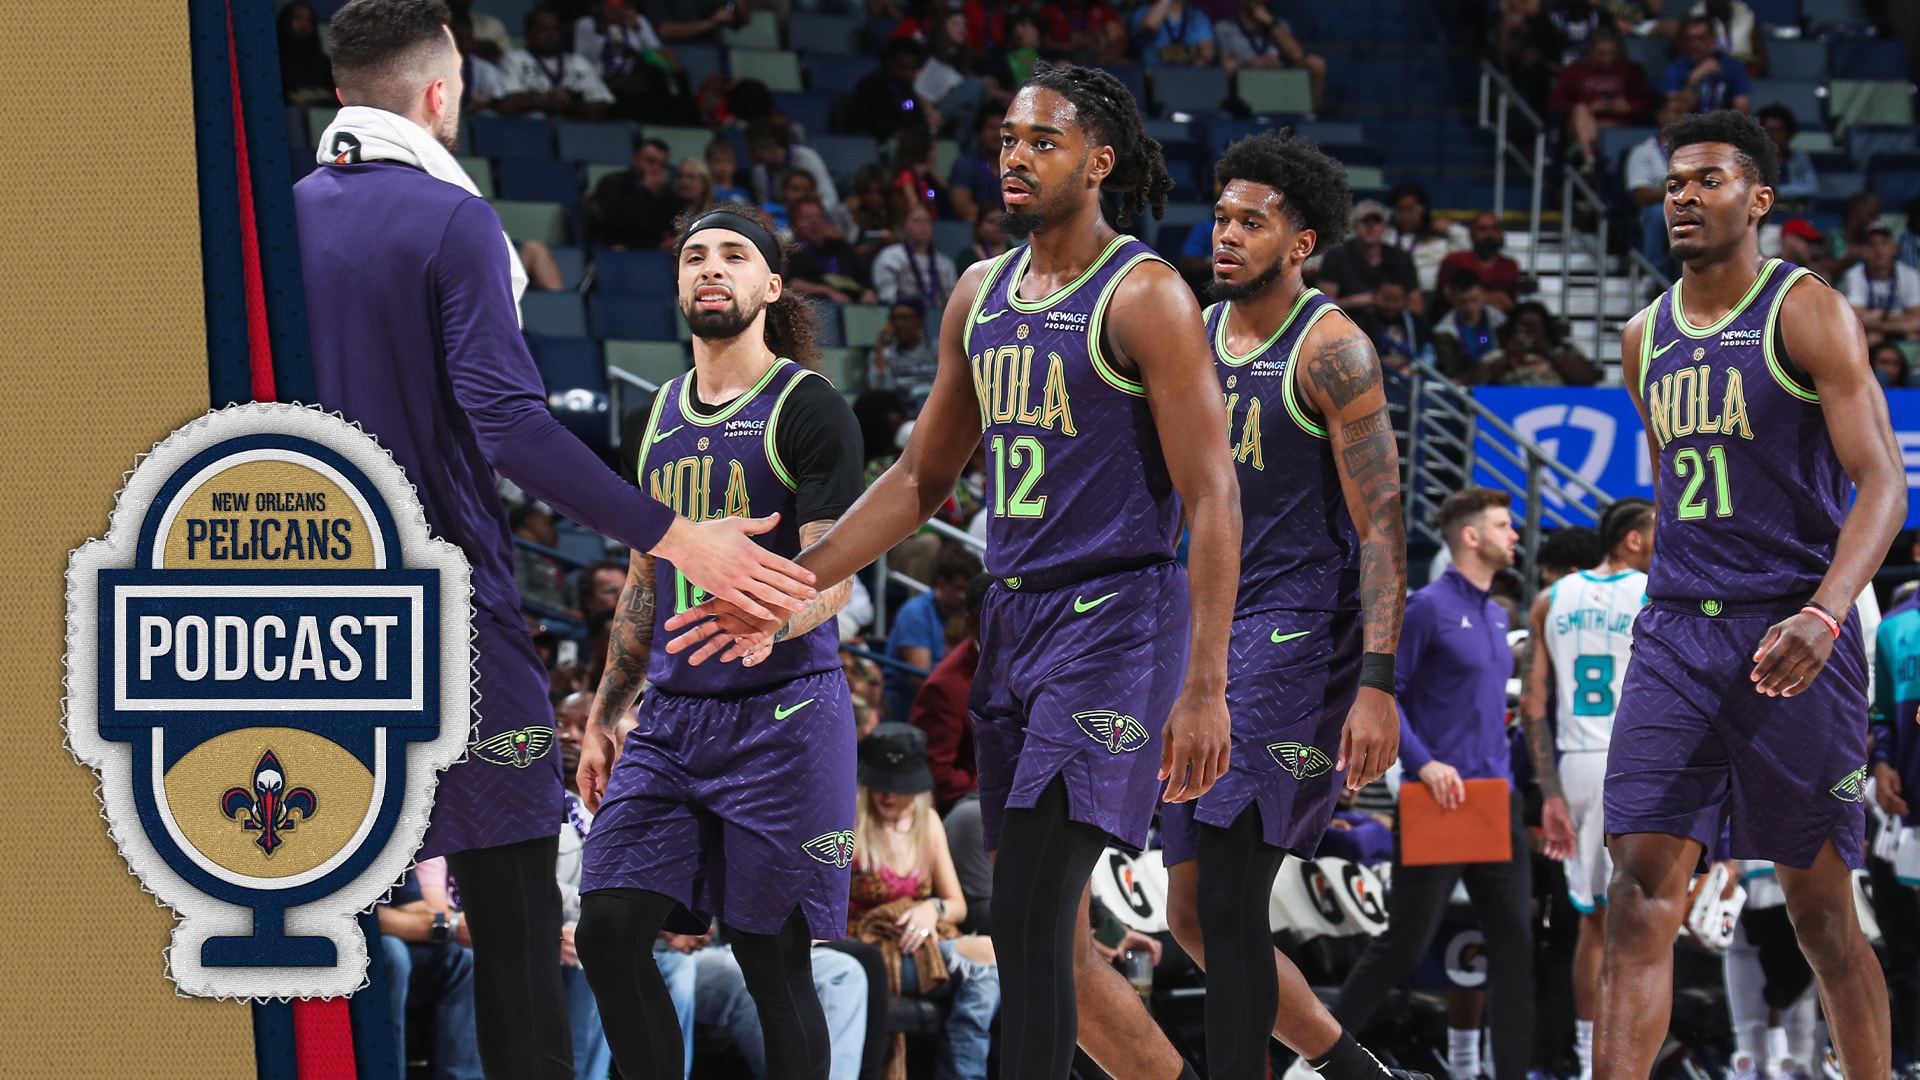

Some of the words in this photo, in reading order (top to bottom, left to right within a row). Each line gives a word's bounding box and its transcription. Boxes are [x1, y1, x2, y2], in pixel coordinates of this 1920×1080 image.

[1044, 322, 1085, 332] PRODUCTS
[1720, 339, 1760, 347] PRODUCTS
[972, 344, 1078, 437] NOLA
[1650, 364, 1755, 450] NOLA
[723, 430, 763, 438] PRODUCTS
[650, 455, 751, 523] NOLA
[991, 435, 1048, 519] 12
[1673, 445, 1734, 521] 21
[1556, 608, 1608, 636] SMITH
[1573, 654, 1615, 717] 8
